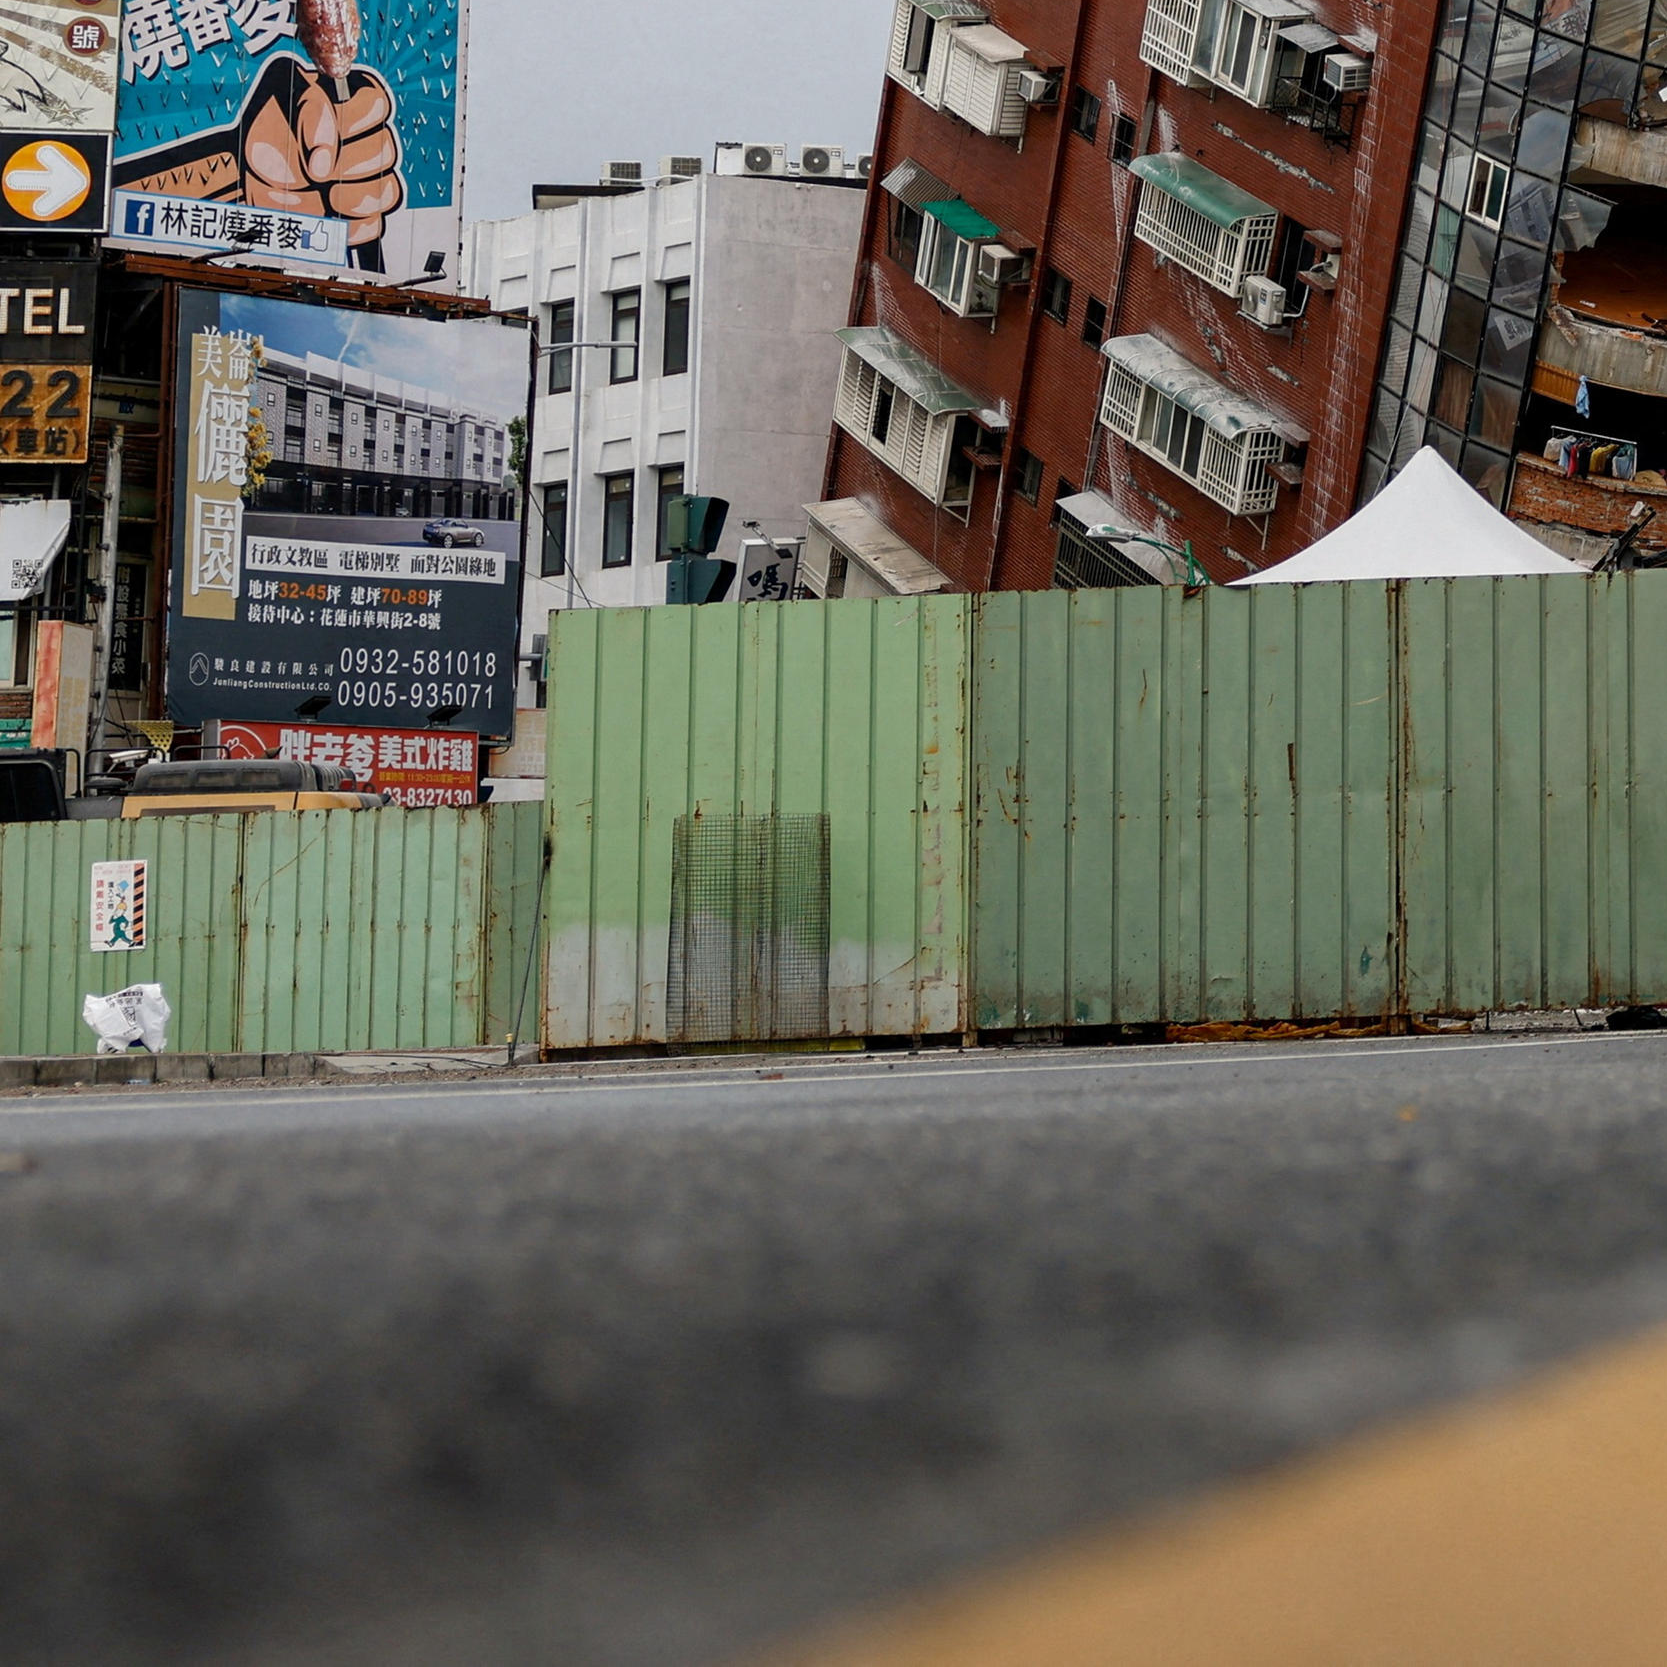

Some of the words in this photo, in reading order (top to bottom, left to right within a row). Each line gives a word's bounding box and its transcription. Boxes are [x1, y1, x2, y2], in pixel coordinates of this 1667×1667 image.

[160, 201, 301, 248] 林記燒番麥
[250, 543, 330, 569] 行政文教區
[339, 549, 401, 574] 電梯別墅
[247, 579, 342, 605] 地坪32-45坪
[350, 585, 443, 609] 建坪70-89坪
[340, 646, 497, 678] 0932-581018
[337, 680, 493, 710] 0905-935071
[378, 735, 474, 773] 美式炸雞
